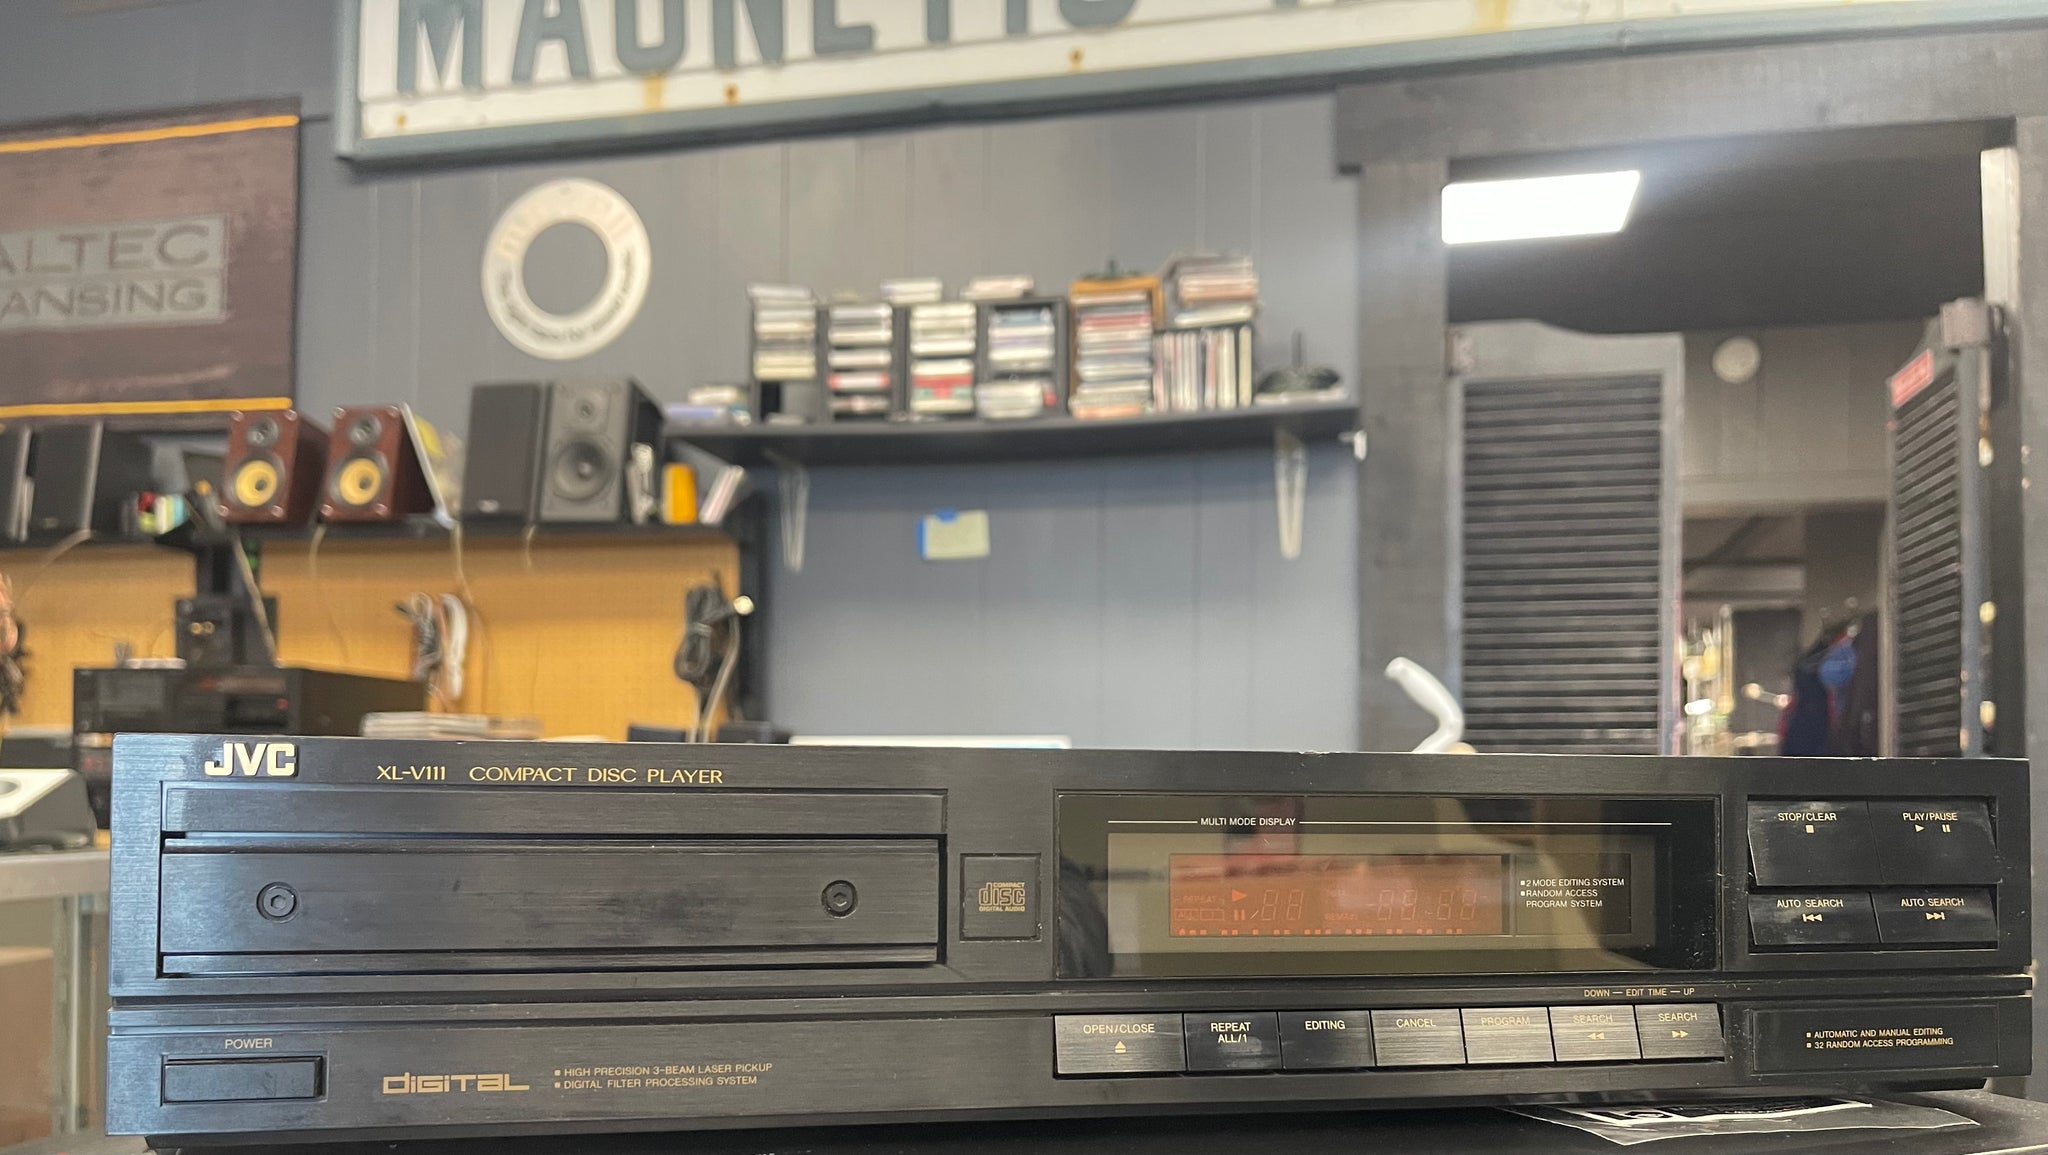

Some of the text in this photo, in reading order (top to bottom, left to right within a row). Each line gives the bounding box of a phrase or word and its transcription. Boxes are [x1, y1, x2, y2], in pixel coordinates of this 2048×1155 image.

[204, 742, 296, 777] JVC
[469, 766, 577, 783] COMPACT
[588, 767, 637, 783] DISC
[647, 768, 723, 784] PLAYER
[1777, 813, 1837, 821] STOP/CLEAR
[1903, 812, 1958, 821] PLAY/PAUSE
[1200, 817, 1296, 827] MULTI MODE DISPLAY
[1532, 879, 1556, 887] MODE
[1558, 878, 1591, 886] EDITING
[1592, 878, 1625, 886] SYSTEM
[1526, 889, 1598, 897] RANDOM ACCESS
[1526, 899, 1603, 908] PROGRAM SYSTEM
[1777, 900, 1843, 908] AUTO SEARCH
[1901, 898, 1964, 907] AUTO SEARCH
[1584, 987, 1695, 997] DOWN EDIT TIME UP
[1481, 1016, 1531, 1026] PROGRAM
[1573, 1014, 1613, 1025] SEARCH
[1658, 1012, 1698, 1022] SEARCH
[1210, 1022, 1251, 1033] REPEAT
[1305, 1020, 1346, 1030] EDITING
[1396, 1017, 1437, 1028] CANCEL
[1083, 1023, 1155, 1034] OPEN/CLOSE
[1814, 1028, 1944, 1039] AUTOMATIC AND MANUAL EDITING
[1218, 1033, 1247, 1043] ALL/1
[1814, 1037, 1954, 1049] 32 RANDOM ACCESS PROGRAMMING
[225, 1038, 272, 1049] POWER
[564, 1063, 773, 1077] HIGH PRECISION 3-BEAM LASER PICKUP
[564, 1076, 757, 1089] DIGITAL FILTER PROCESSING SYSTEM
